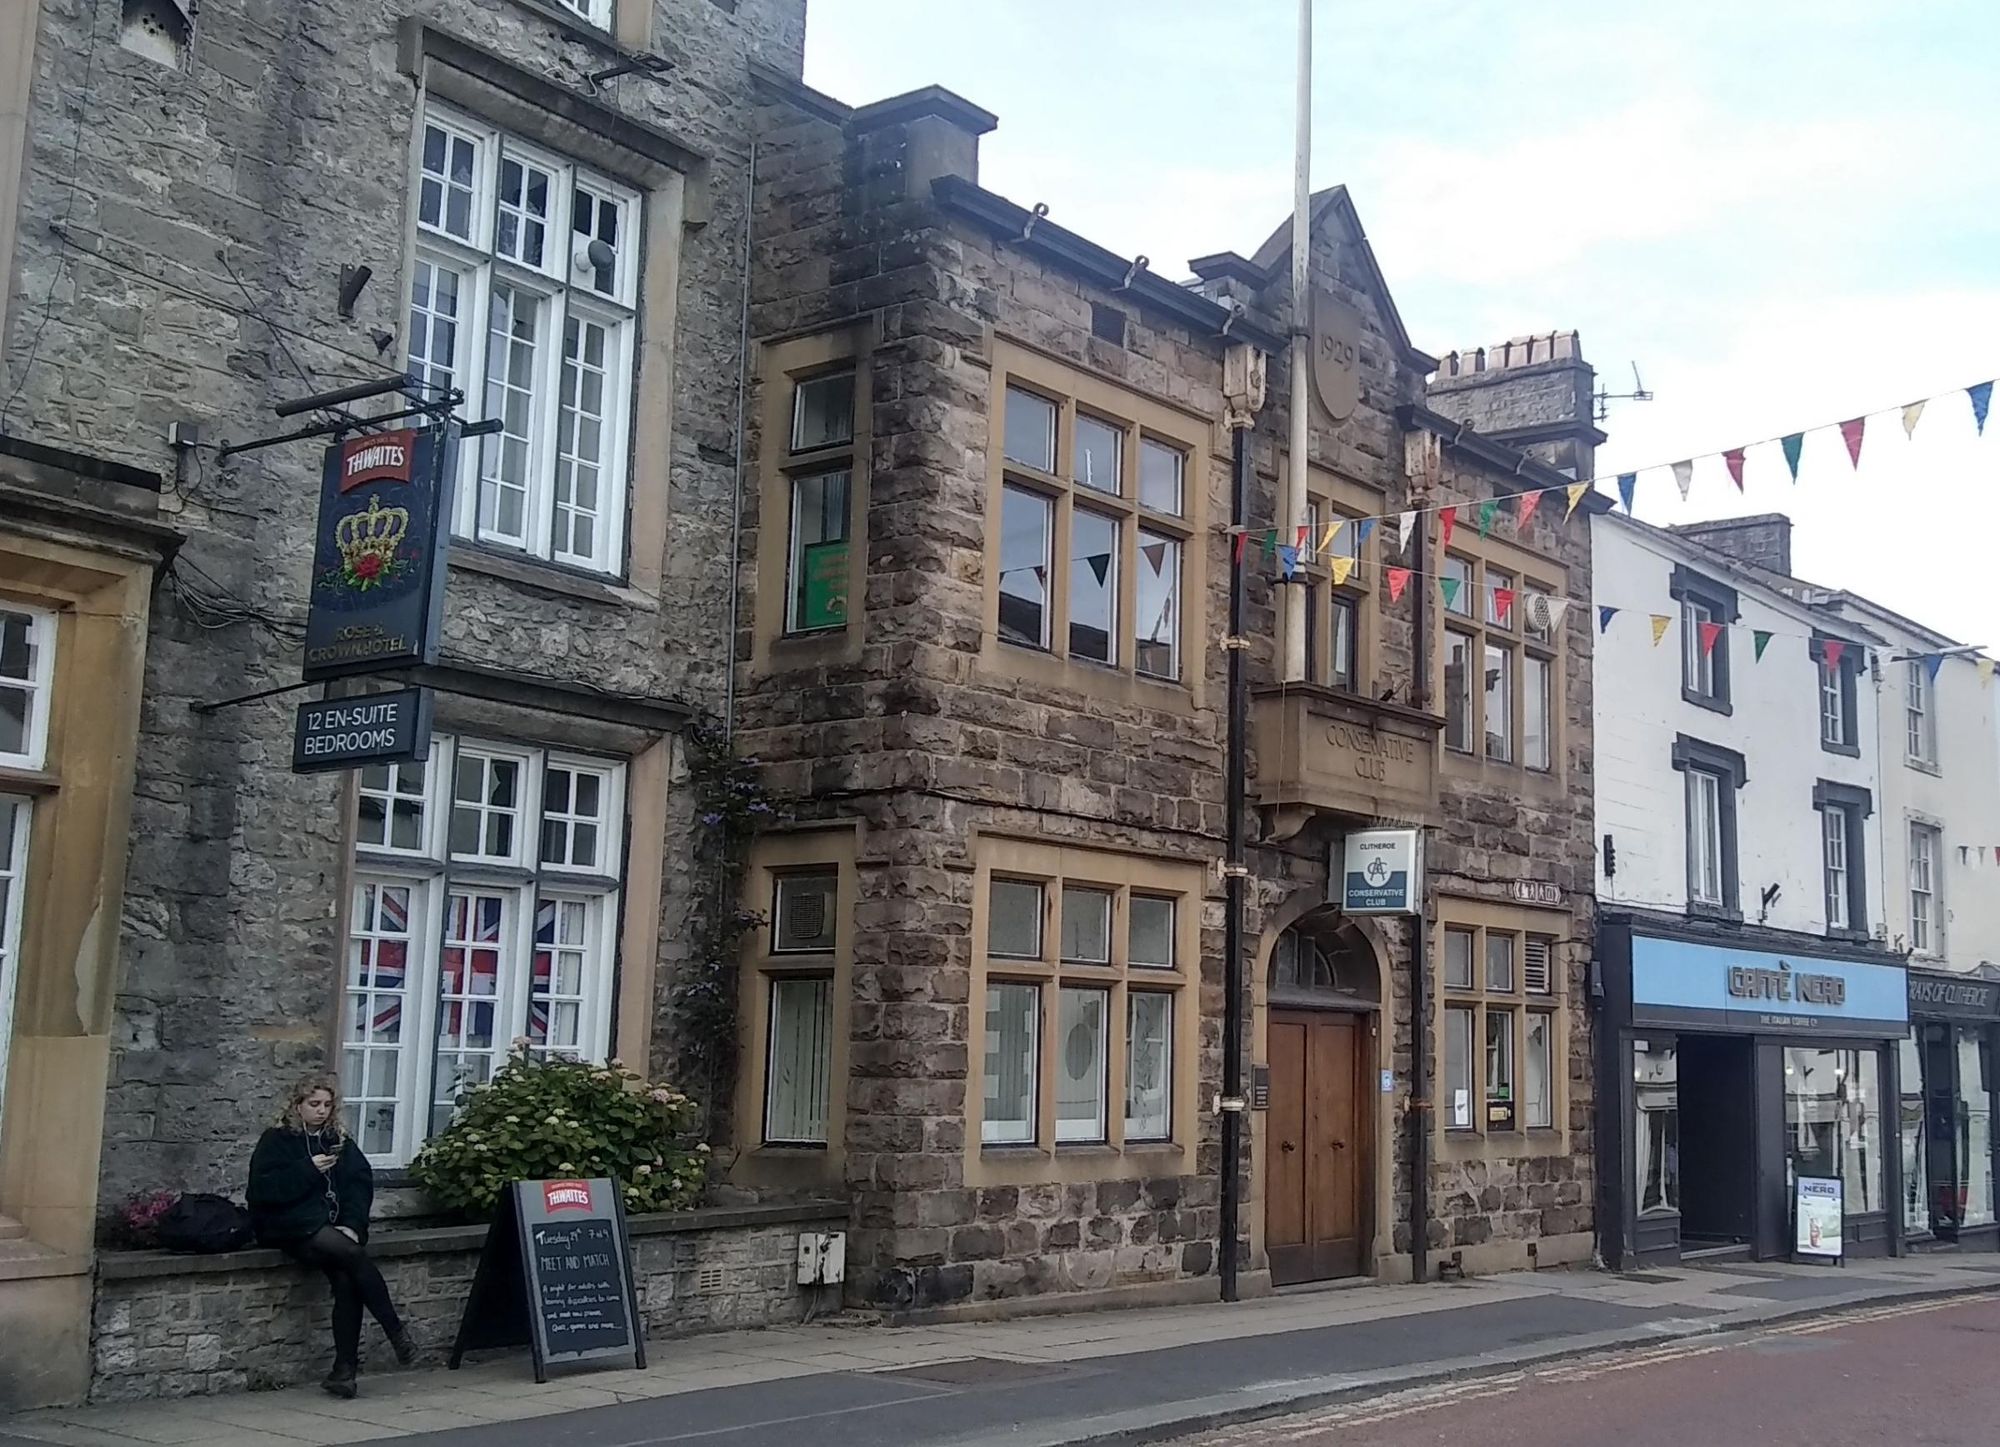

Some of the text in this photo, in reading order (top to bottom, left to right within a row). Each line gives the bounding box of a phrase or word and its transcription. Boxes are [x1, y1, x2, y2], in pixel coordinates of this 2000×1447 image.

[346, 445, 405, 477] THWAITES
[308, 633, 407, 661] CROWN HOTEL
[307, 703, 398, 730] 12 EN-SUITE
[304, 728, 396, 755] BEDROOMS
[1326, 725, 1413, 764] CONSERVATIVE
[1355, 757, 1385, 782] CLUB
[1348, 888, 1404, 897] CONSERVATIVE
[1365, 898, 1386, 906] CLUB
[1795, 972, 1845, 1005] NERO
[547, 1188, 588, 1206] THWAITES
[1804, 1185, 1835, 1194] NERO
[535, 1230, 570, 1250] Tuesday
[540, 1253, 610, 1271] MEET AND MATCH
